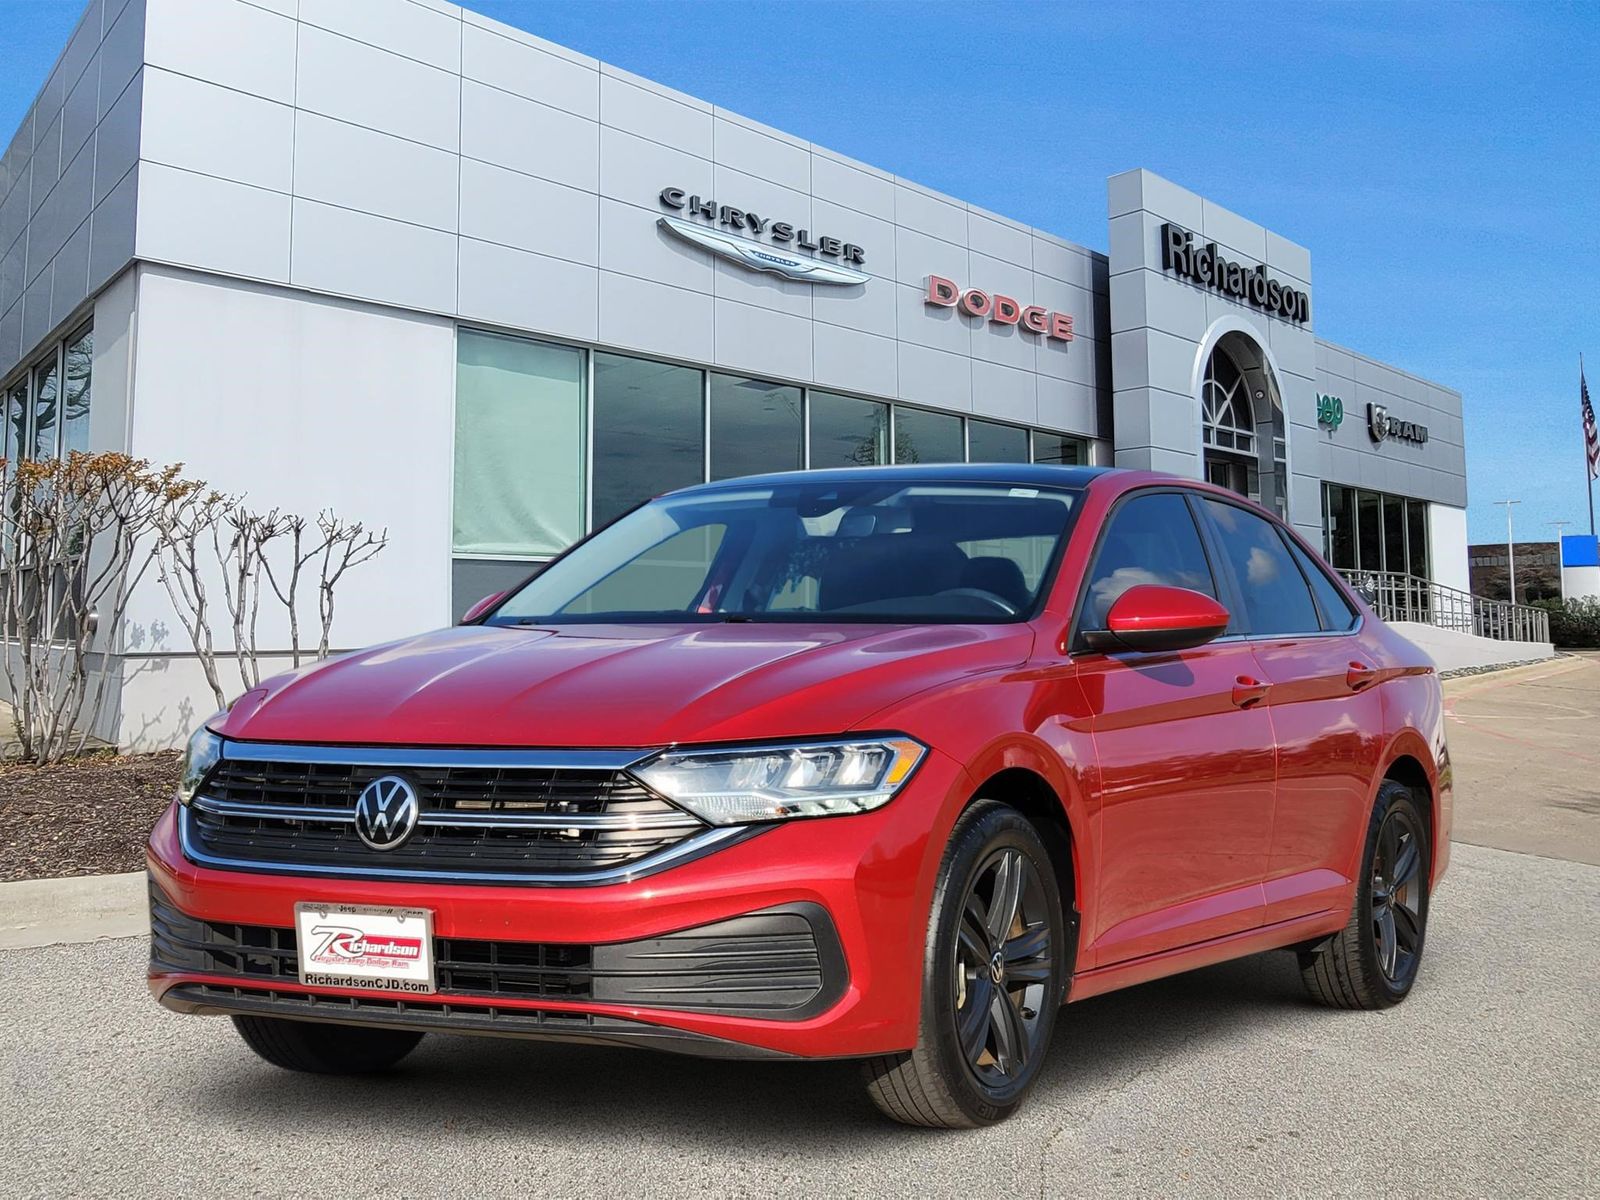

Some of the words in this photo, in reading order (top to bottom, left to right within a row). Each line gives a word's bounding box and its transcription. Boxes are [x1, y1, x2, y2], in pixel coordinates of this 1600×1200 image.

[659, 186, 866, 264] CHRYSLER
[754, 252, 796, 266] CHRYSLER
[1161, 223, 1310, 323] Richardson
[923, 274, 1074, 342] DODGE
[1388, 417, 1429, 443] RAM
[339, 905, 356, 913] Jeep
[310, 925, 418, 961] Richardson
[305, 973, 429, 992] RichardsonCJD.com
